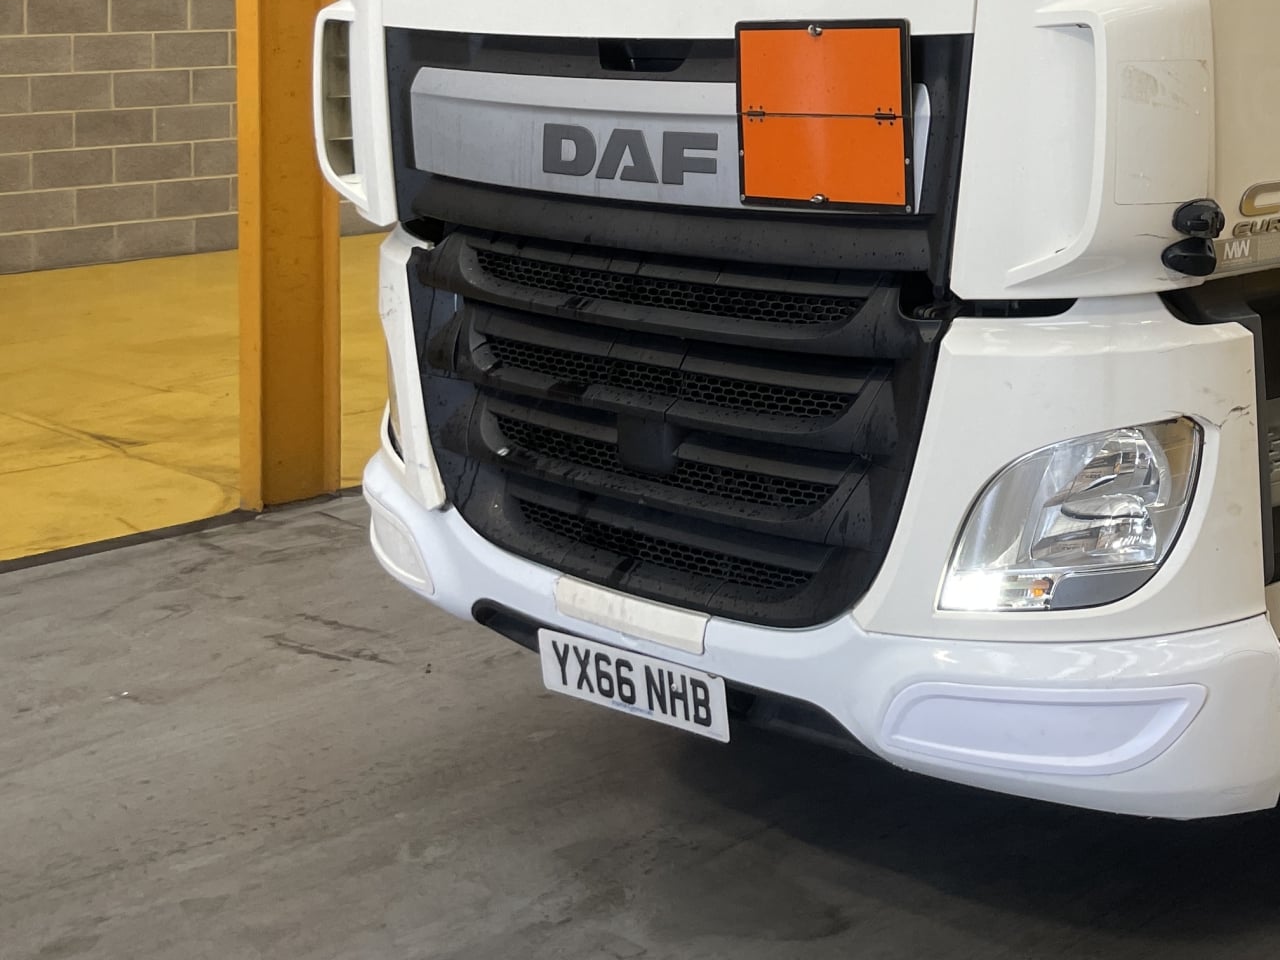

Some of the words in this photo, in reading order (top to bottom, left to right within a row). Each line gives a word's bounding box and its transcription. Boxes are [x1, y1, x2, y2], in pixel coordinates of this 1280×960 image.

[543, 123, 718, 185] DAF
[552, 640, 636, 705] YX66
[644, 664, 712, 727] NHB
